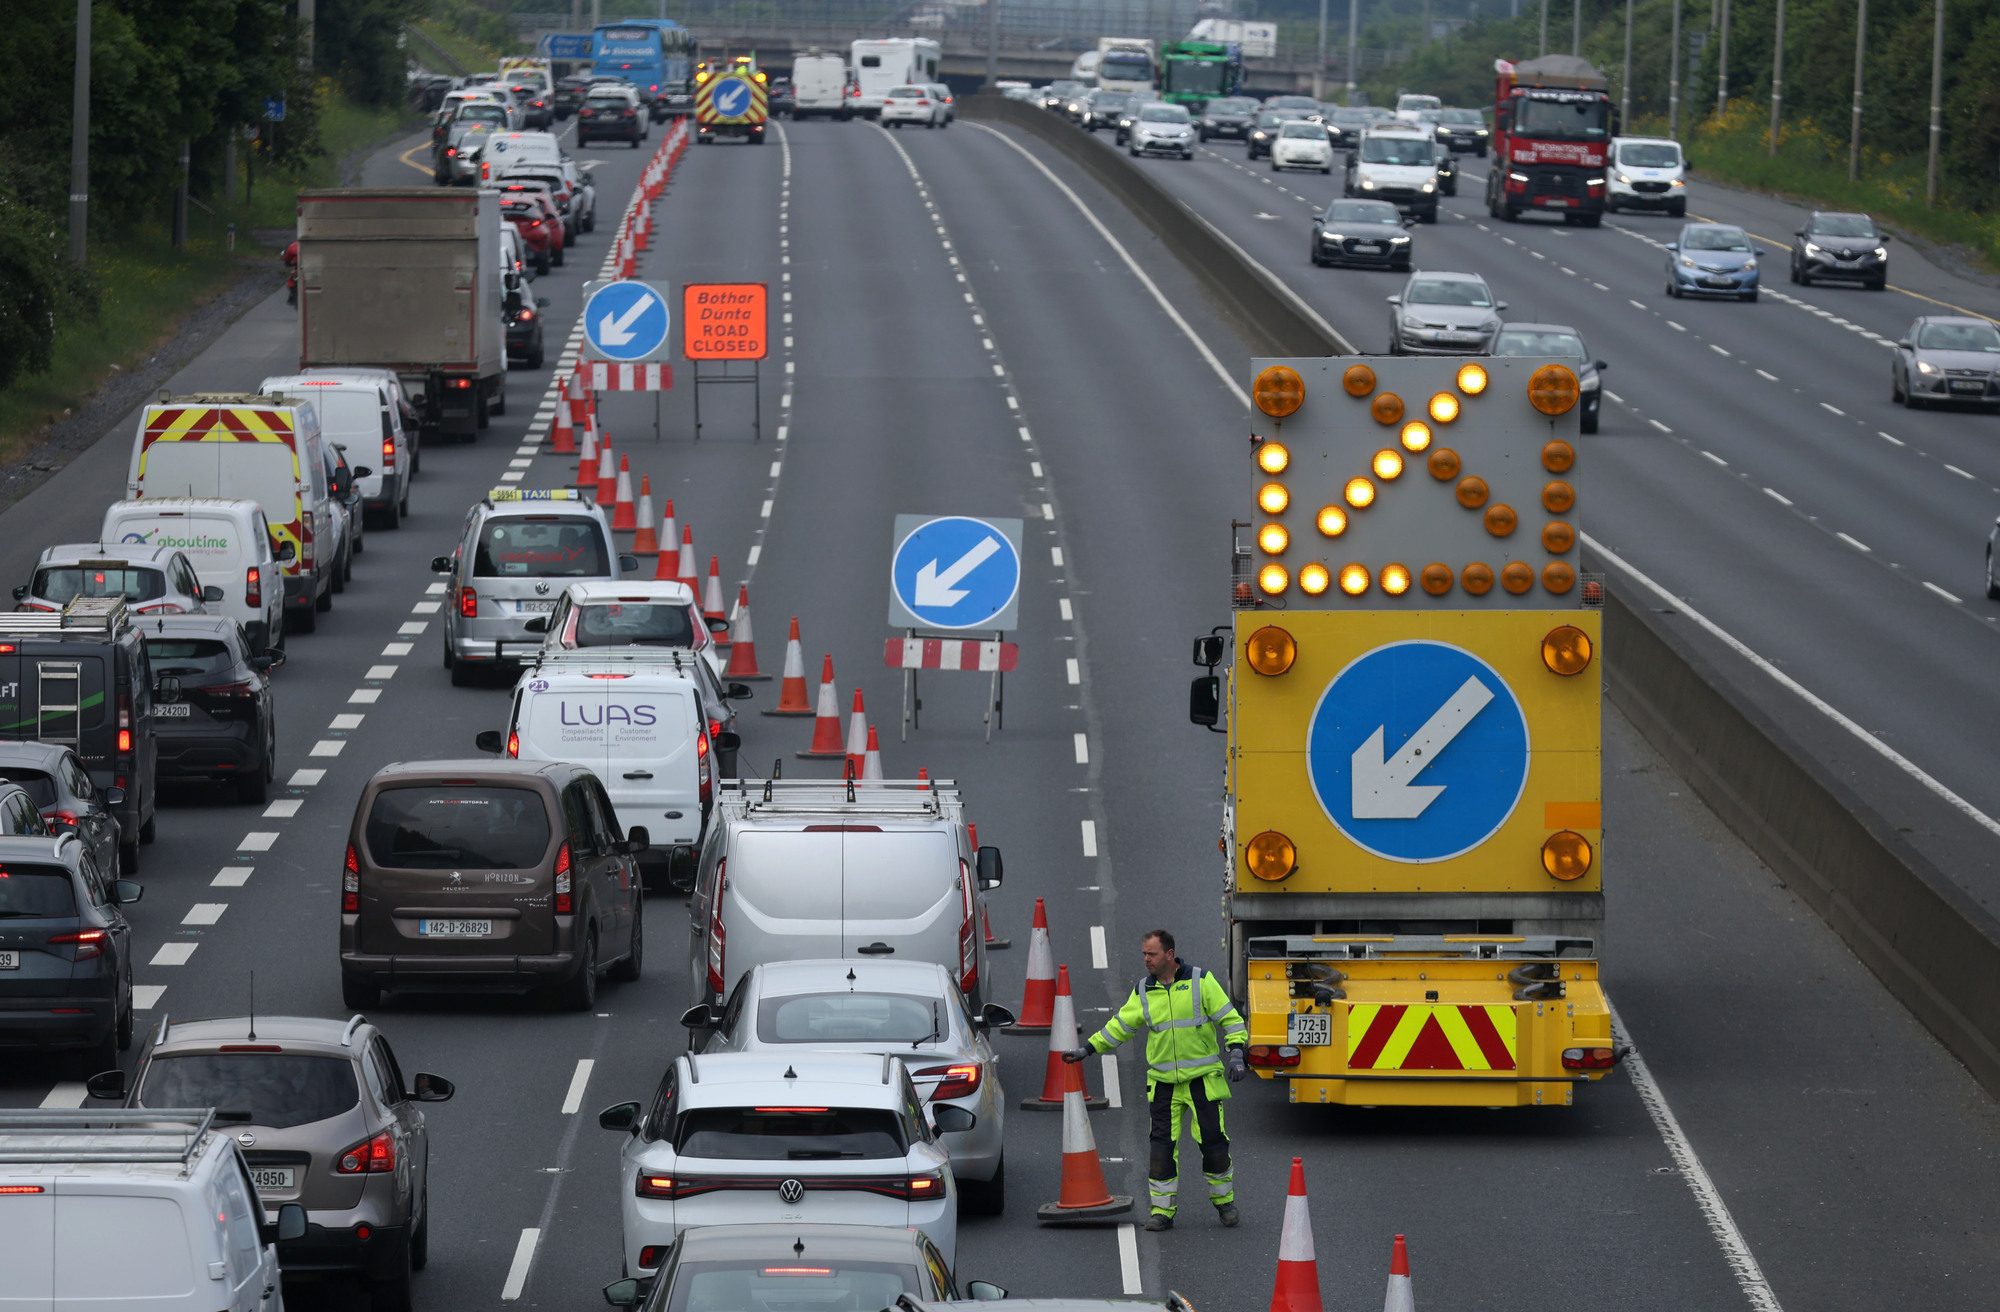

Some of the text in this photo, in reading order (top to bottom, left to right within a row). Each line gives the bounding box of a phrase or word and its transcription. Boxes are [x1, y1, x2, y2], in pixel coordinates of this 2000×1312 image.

[703, 325, 749, 337] ROAD
[693, 340, 759, 353] CLOSED
[522, 489, 551, 500] TAXI
[157, 535, 228, 548] aboutime
[0, 682, 19, 698] FT
[530, 680, 547, 691] 21
[561, 701, 657, 726] LUAS
[484, 872, 519, 882] HORIZON
[429, 922, 489, 933] 142-D-26829
[1297, 1031, 1328, 1044] 23137
